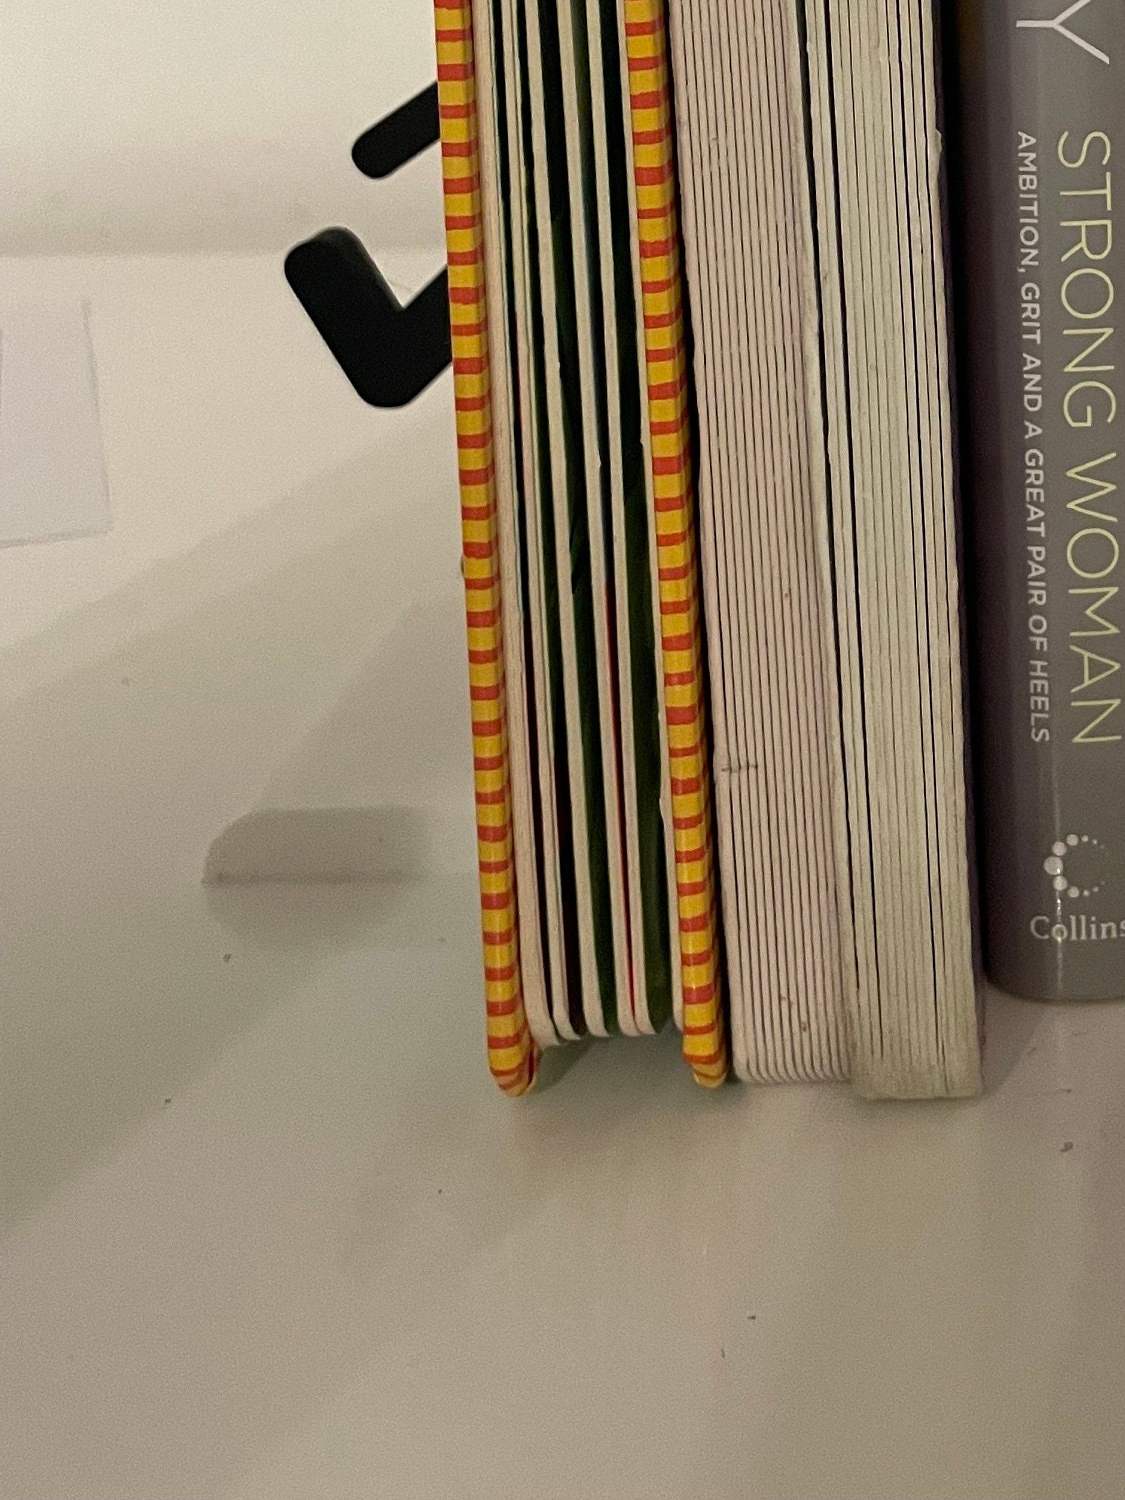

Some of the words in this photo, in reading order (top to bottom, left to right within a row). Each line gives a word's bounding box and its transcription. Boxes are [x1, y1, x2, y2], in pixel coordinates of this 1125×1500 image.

[1017, 131, 1040, 274] AMBITION,
[1020, 282, 1042, 343] GRIT
[1057, 130, 1117, 428] STRONG
[1022, 353, 1043, 413] AND
[1024, 421, 1043, 441] A
[1024, 449, 1047, 538] GREAT
[1026, 545, 1047, 606] PAIR
[1065, 452, 1123, 743] WOMAN
[1027, 614, 1049, 652] OF
[1028, 659, 1051, 743] HEELS
